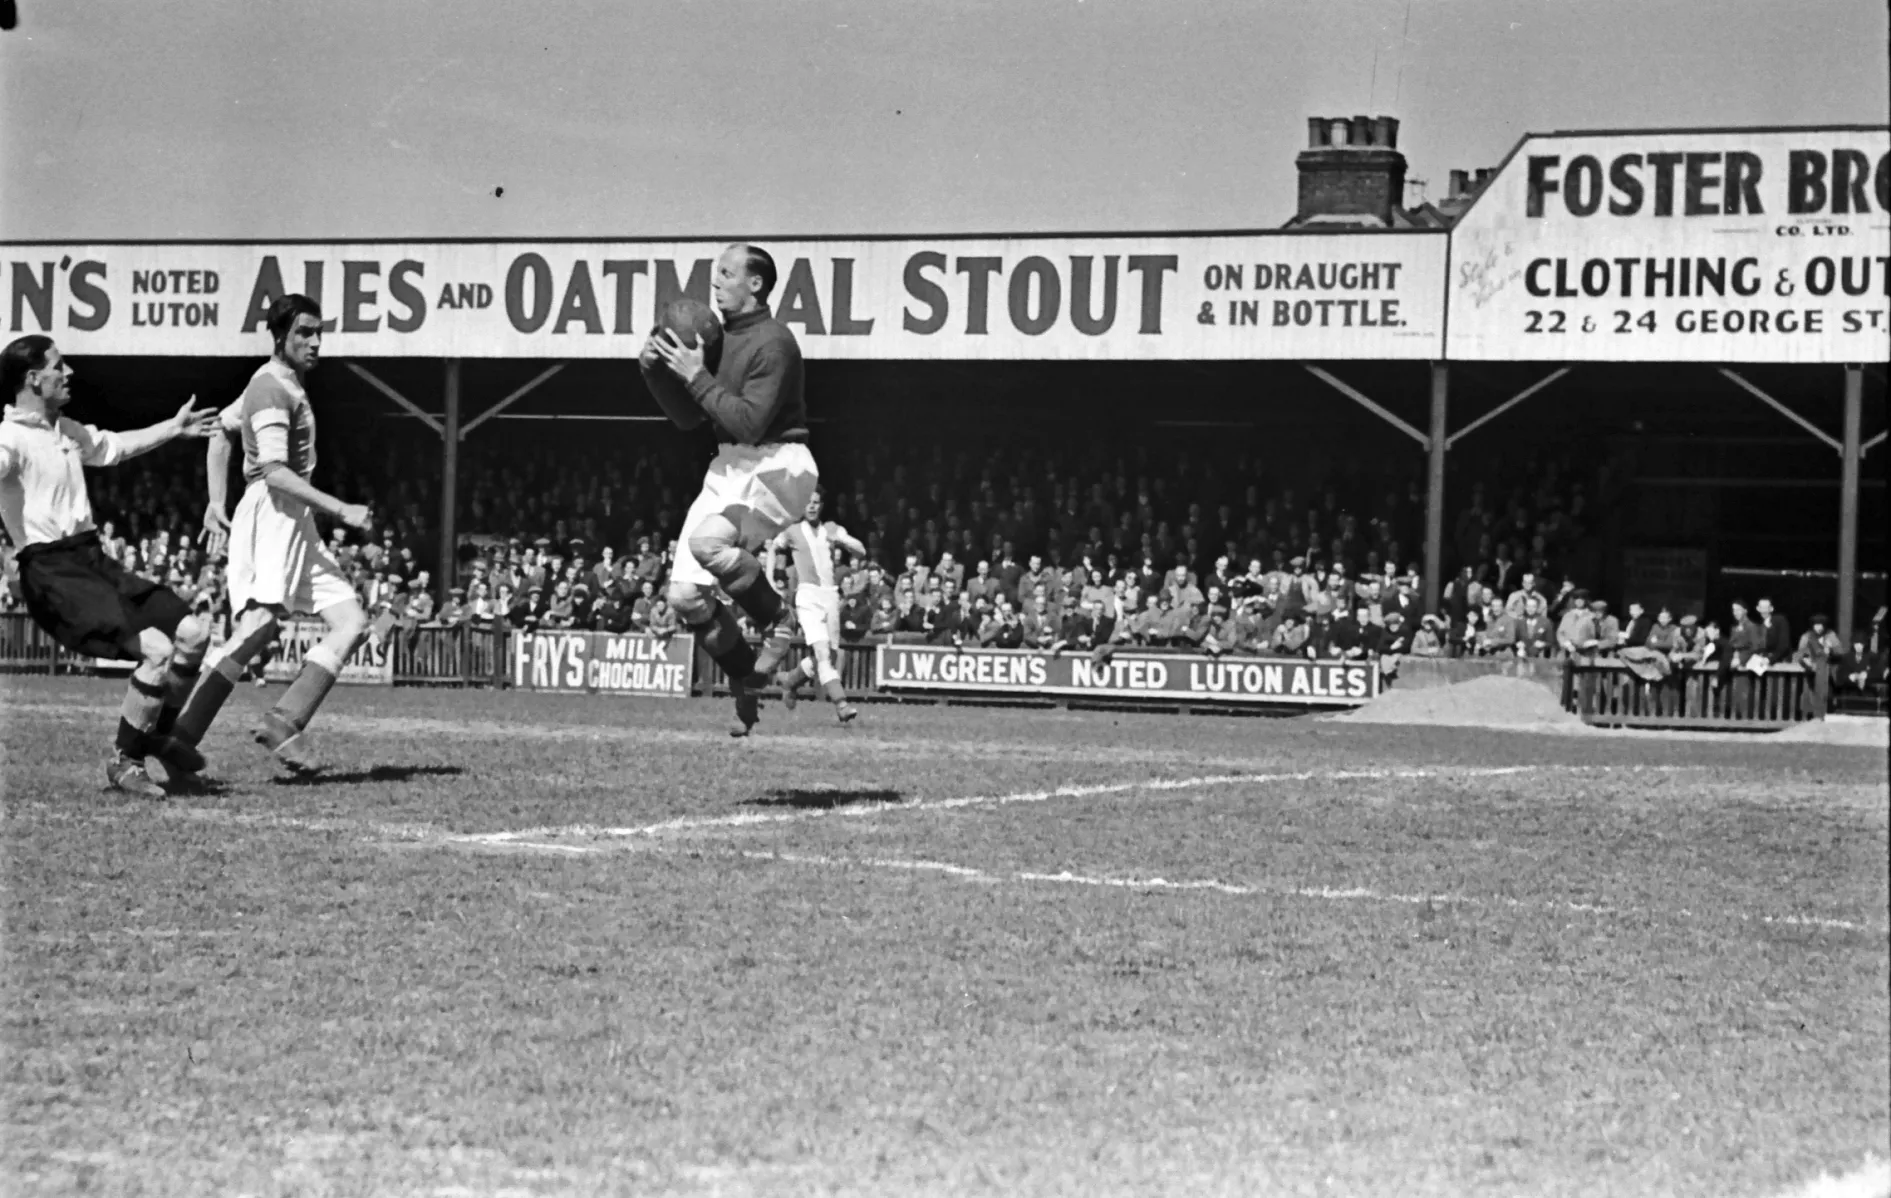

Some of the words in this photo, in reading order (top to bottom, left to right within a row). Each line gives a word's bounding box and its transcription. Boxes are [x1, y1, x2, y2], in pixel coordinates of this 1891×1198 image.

[1525, 152, 1764, 218] FOSTER
[132, 269, 220, 294] NOTED
[1204, 264, 1245, 291] ON
[1255, 262, 1402, 291] DRAUGHT
[1524, 257, 1761, 298] CLOTHING
[1774, 267, 1795, 298] &
[0, 254, 112, 332] N'S
[241, 255, 427, 333] ALES
[437, 282, 493, 310] AND
[505, 252, 876, 335] OATMAL
[902, 251, 1179, 336] STOUT
[132, 302, 219, 327] LUTON
[1196, 300, 1217, 326] &
[1228, 300, 1259, 326] IN
[1271, 299, 1408, 328] BOTTLE.
[1524, 310, 1567, 334] 22
[1580, 314, 1597, 334] &
[1612, 310, 1658, 333] 24
[1675, 309, 1824, 334] GEORGE
[1842, 309, 1887, 334] ST.
[605, 638, 668, 661] MILK
[588, 659, 686, 692] CHOCOLATE
[1072, 658, 1168, 689] NOTED
[1190, 663, 1284, 694] LUTON
[1291, 665, 1368, 697] ALES
